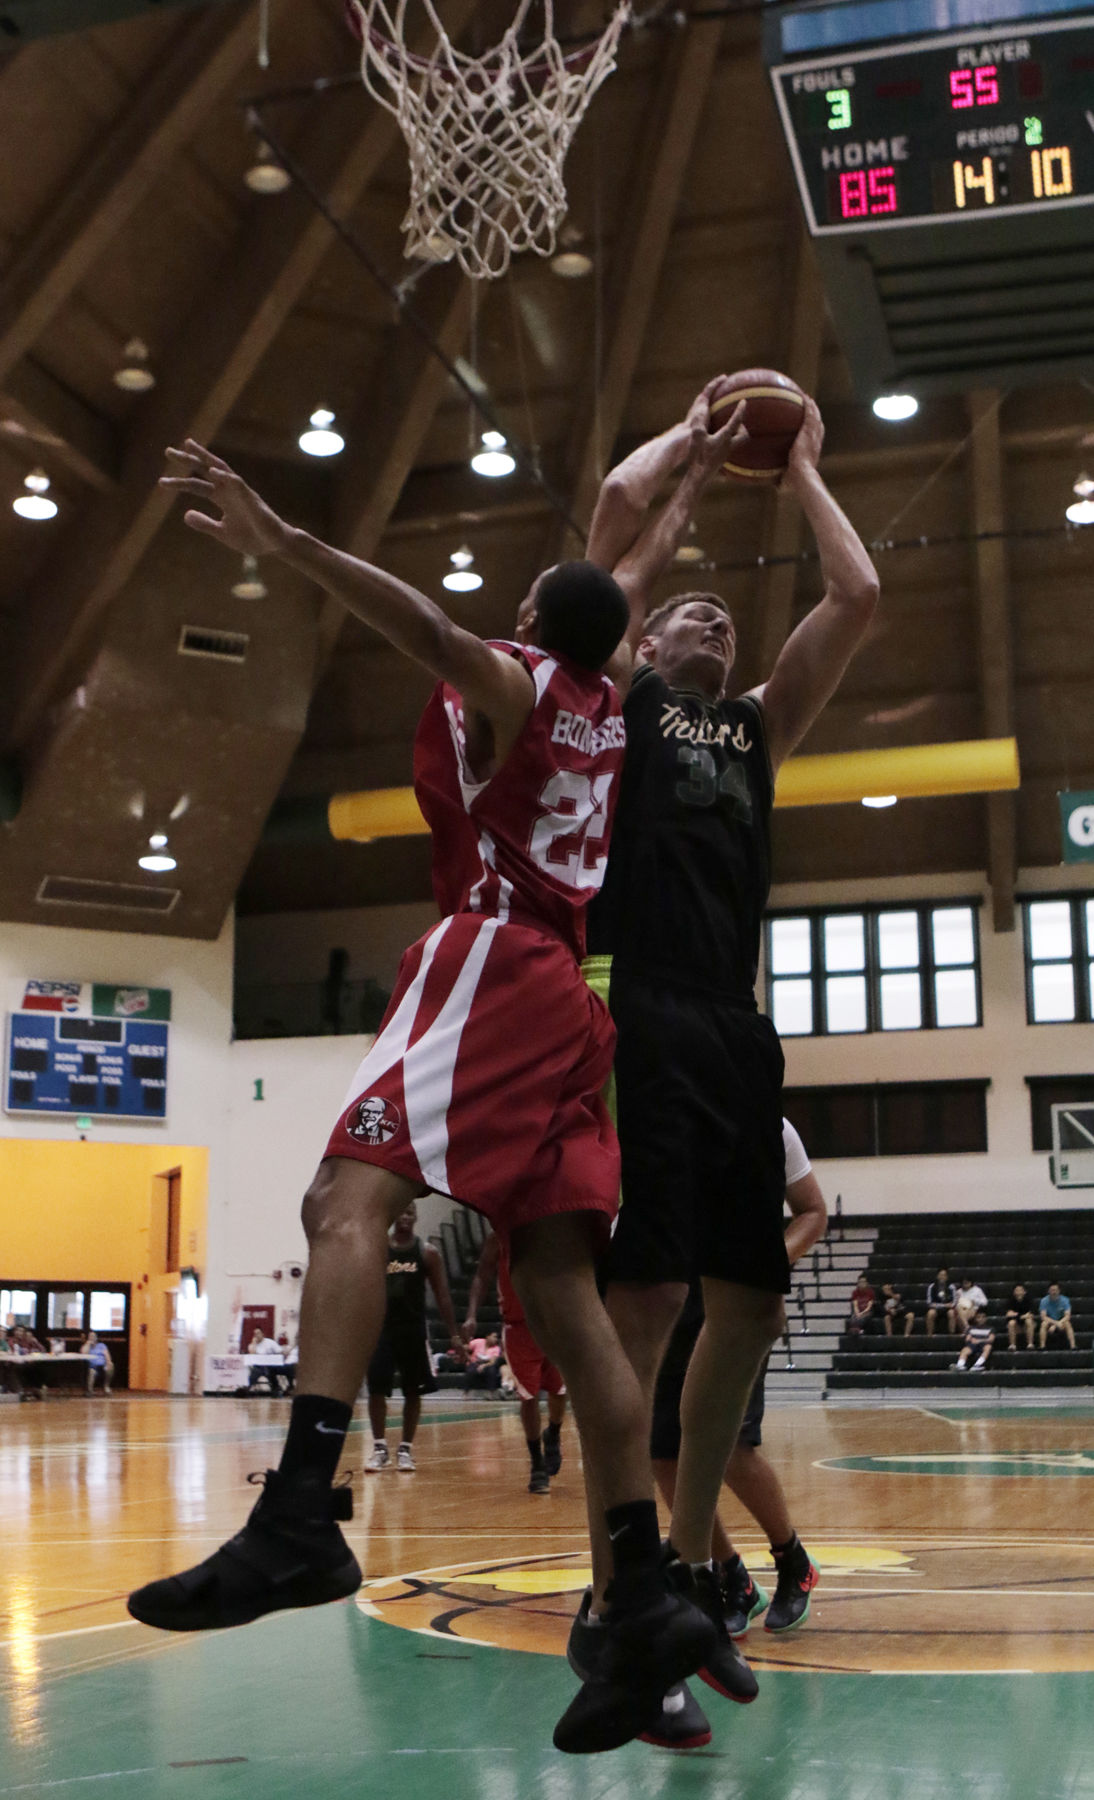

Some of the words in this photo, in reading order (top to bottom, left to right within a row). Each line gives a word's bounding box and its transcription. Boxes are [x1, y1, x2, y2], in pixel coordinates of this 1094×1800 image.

[957, 40, 1032, 67] PLAYER
[792, 67, 855, 93] FOULS
[950, 65, 999, 109] 55
[825, 88, 852, 130] 3
[956, 124, 1020, 148] PERIOD
[821, 136, 910, 170] HOME
[839, 165, 897, 218] 85
[14, 1037, 49, 1050] HOME
[128, 1044, 166, 1057] GUEST
[253, 1078, 264, 1100] 1
[379, 1118, 397, 1129] KFC
